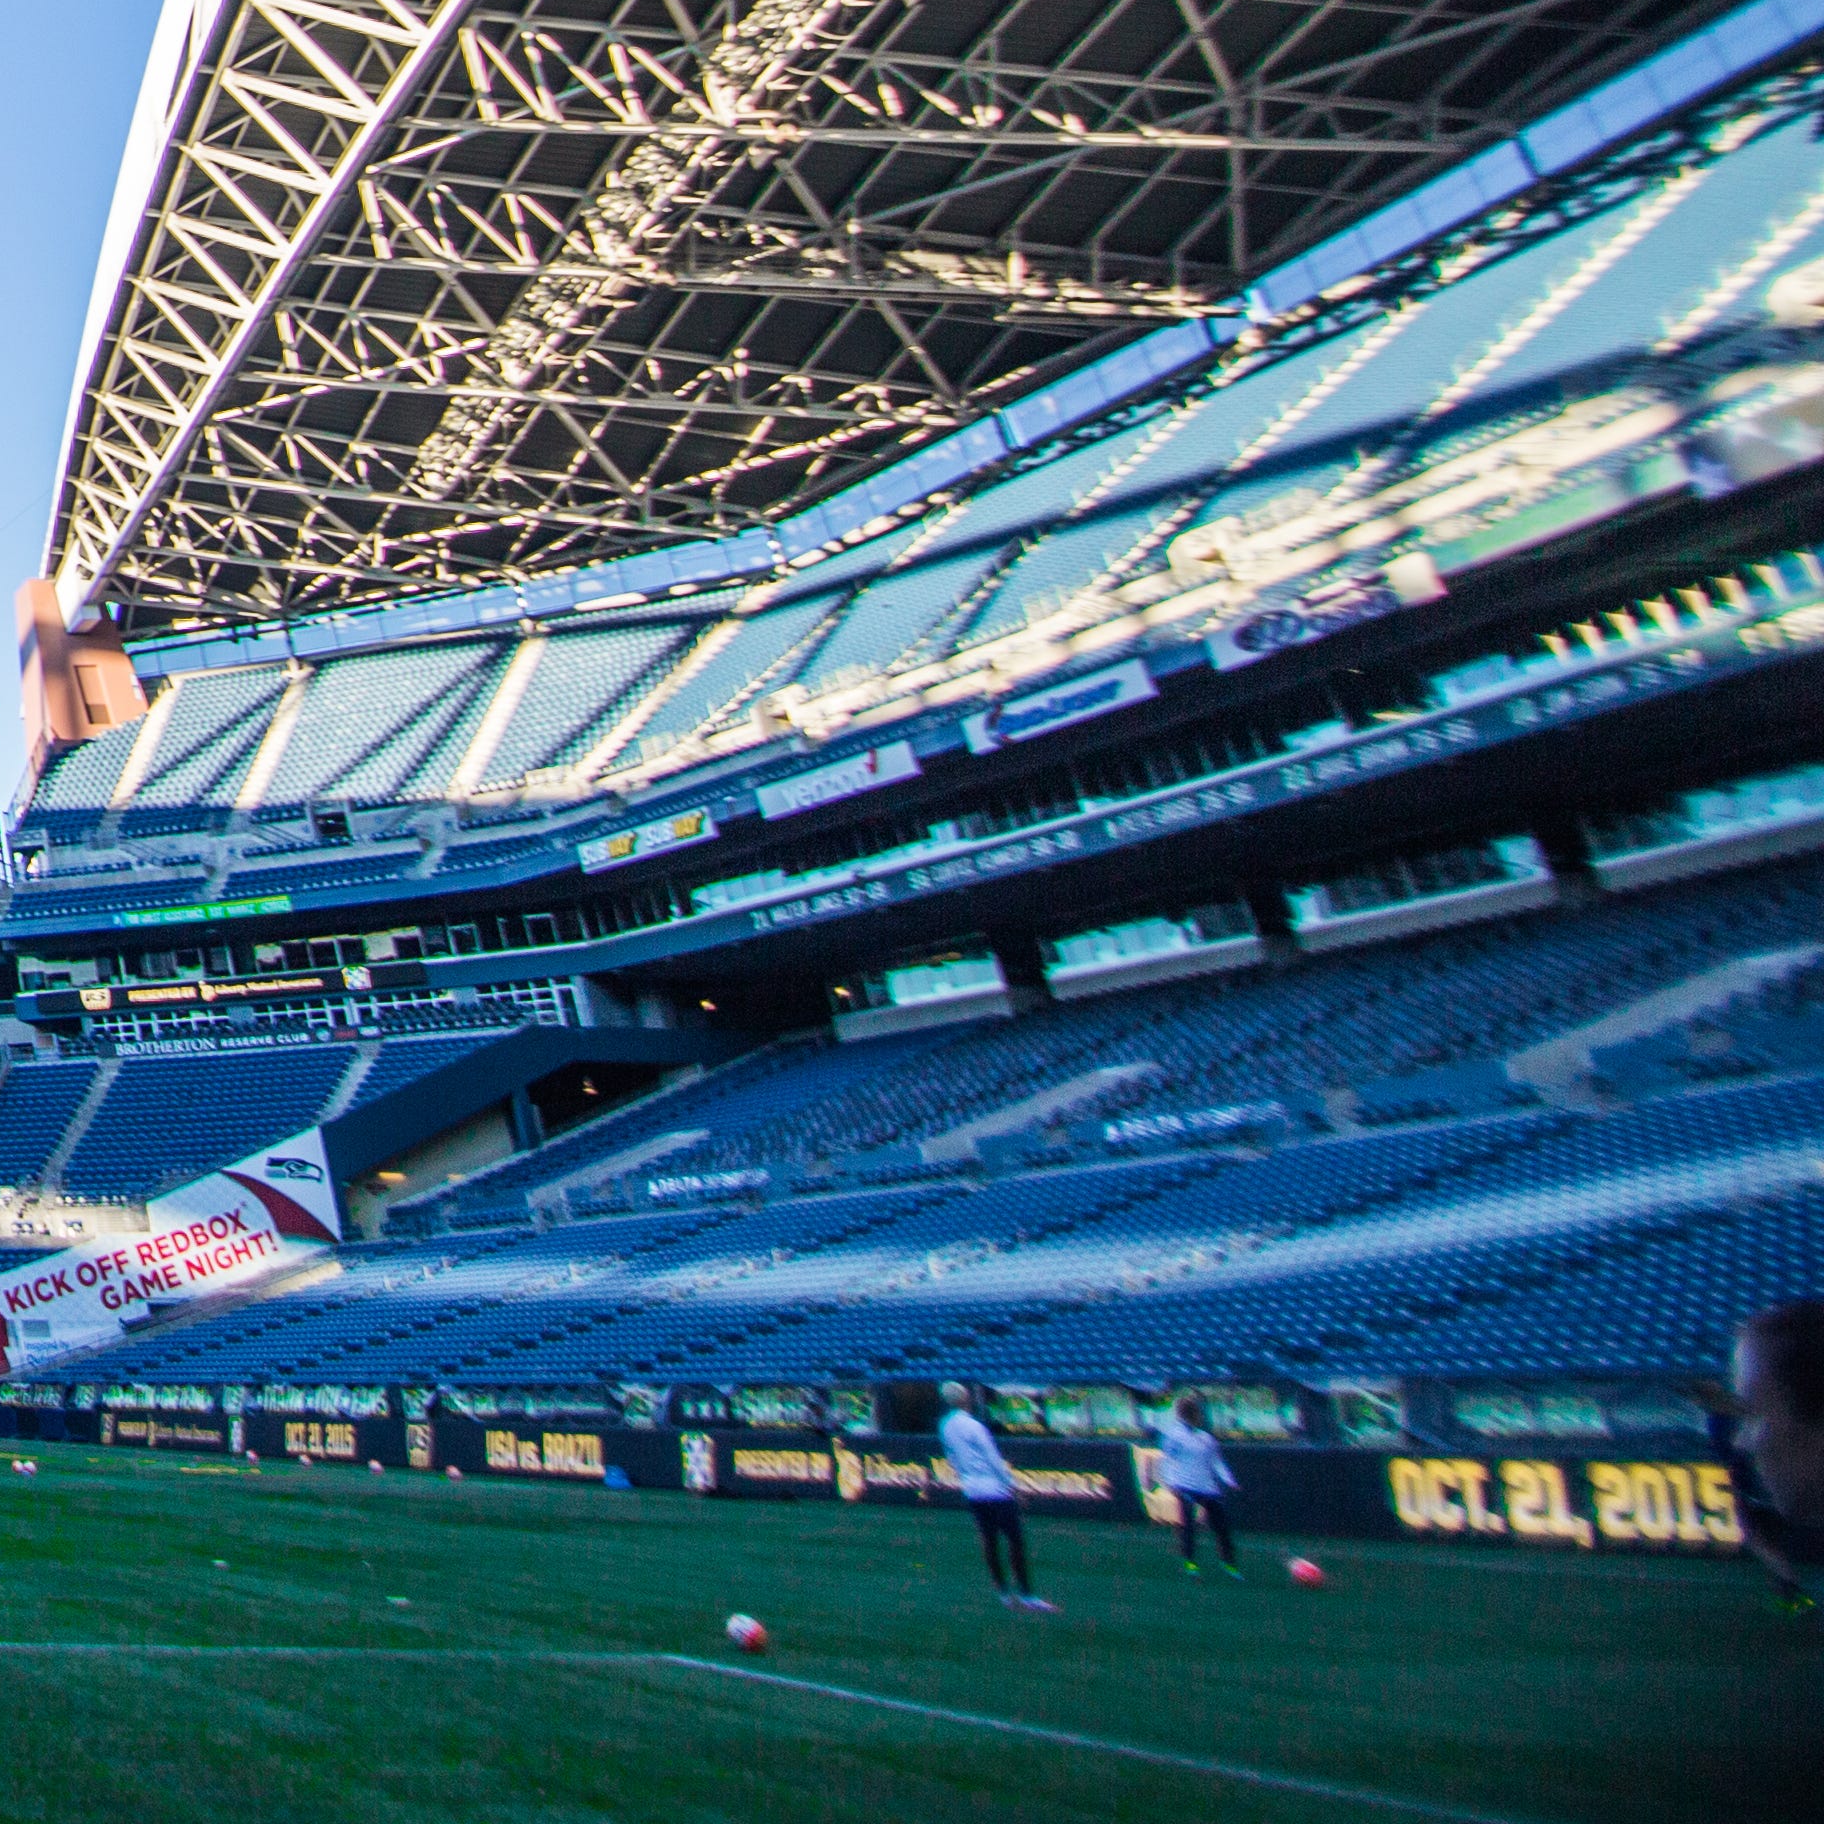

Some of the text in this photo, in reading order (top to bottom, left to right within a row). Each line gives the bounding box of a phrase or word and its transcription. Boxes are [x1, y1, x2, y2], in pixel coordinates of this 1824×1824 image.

[115, 1033, 309, 1056] BROTHERTON RESERVE CLUB
[4, 1209, 249, 1314] KICK OFF REDBOX
[99, 1229, 280, 1311] GAME NIGHT!
[542, 1431, 606, 1476] BRAZIL
[1388, 1458, 1743, 1548] OCT. 21, 2015
